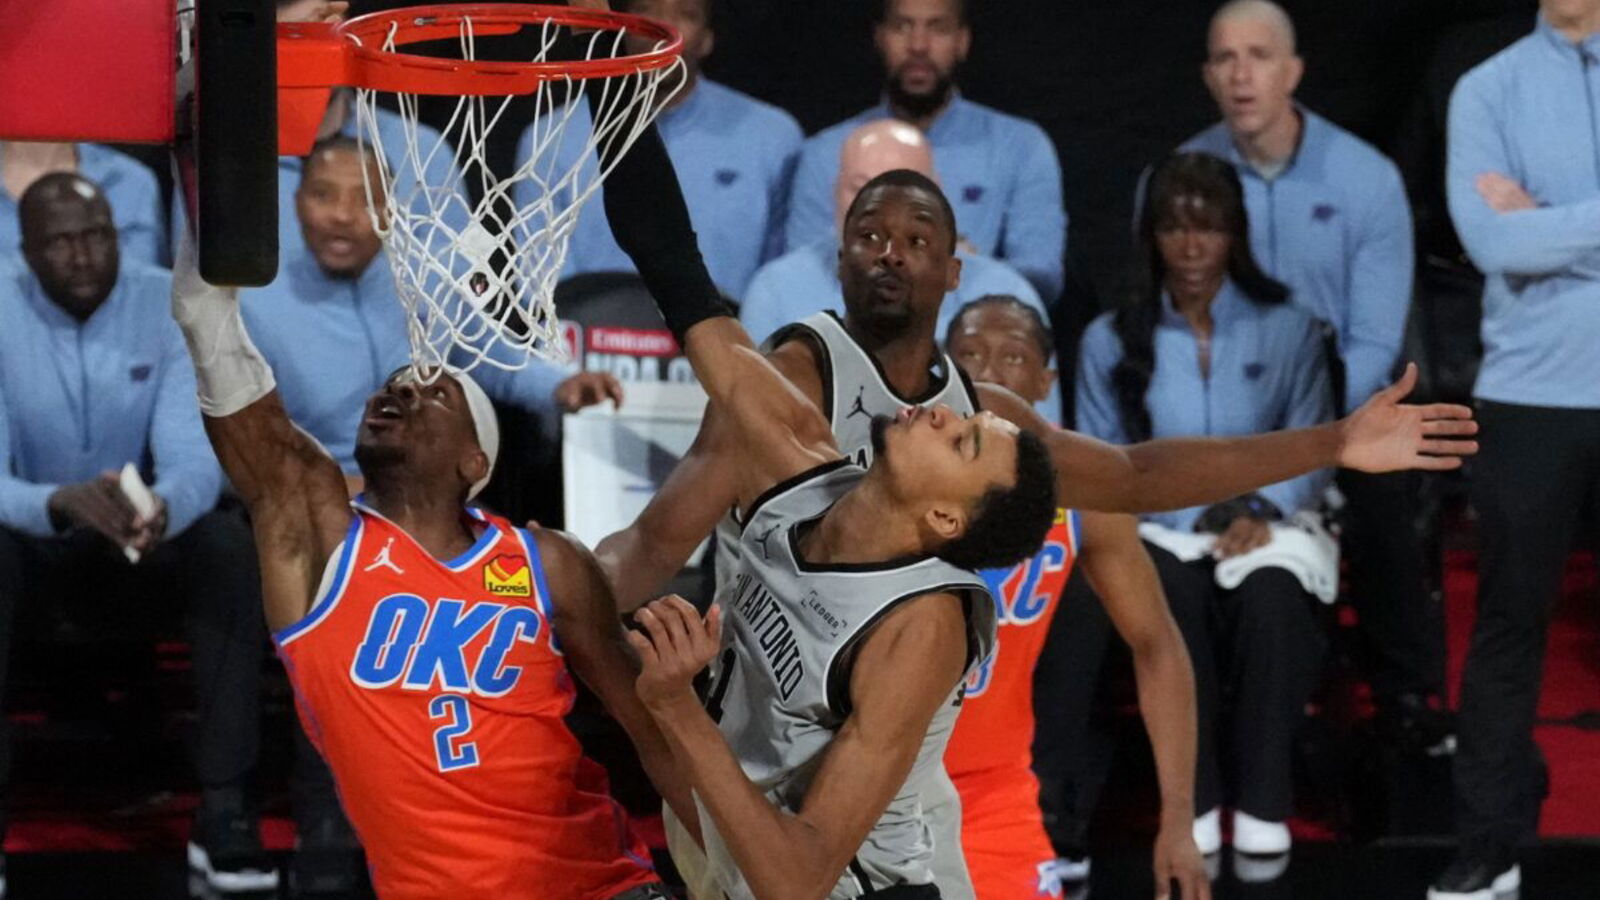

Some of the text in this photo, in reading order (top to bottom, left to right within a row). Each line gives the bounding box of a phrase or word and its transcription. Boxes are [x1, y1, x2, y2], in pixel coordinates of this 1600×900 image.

[350, 593, 541, 698] OKC
[739, 583, 804, 701] ANTONIO
[808, 598, 839, 629] LEDGER
[429, 695, 481, 773] 2
